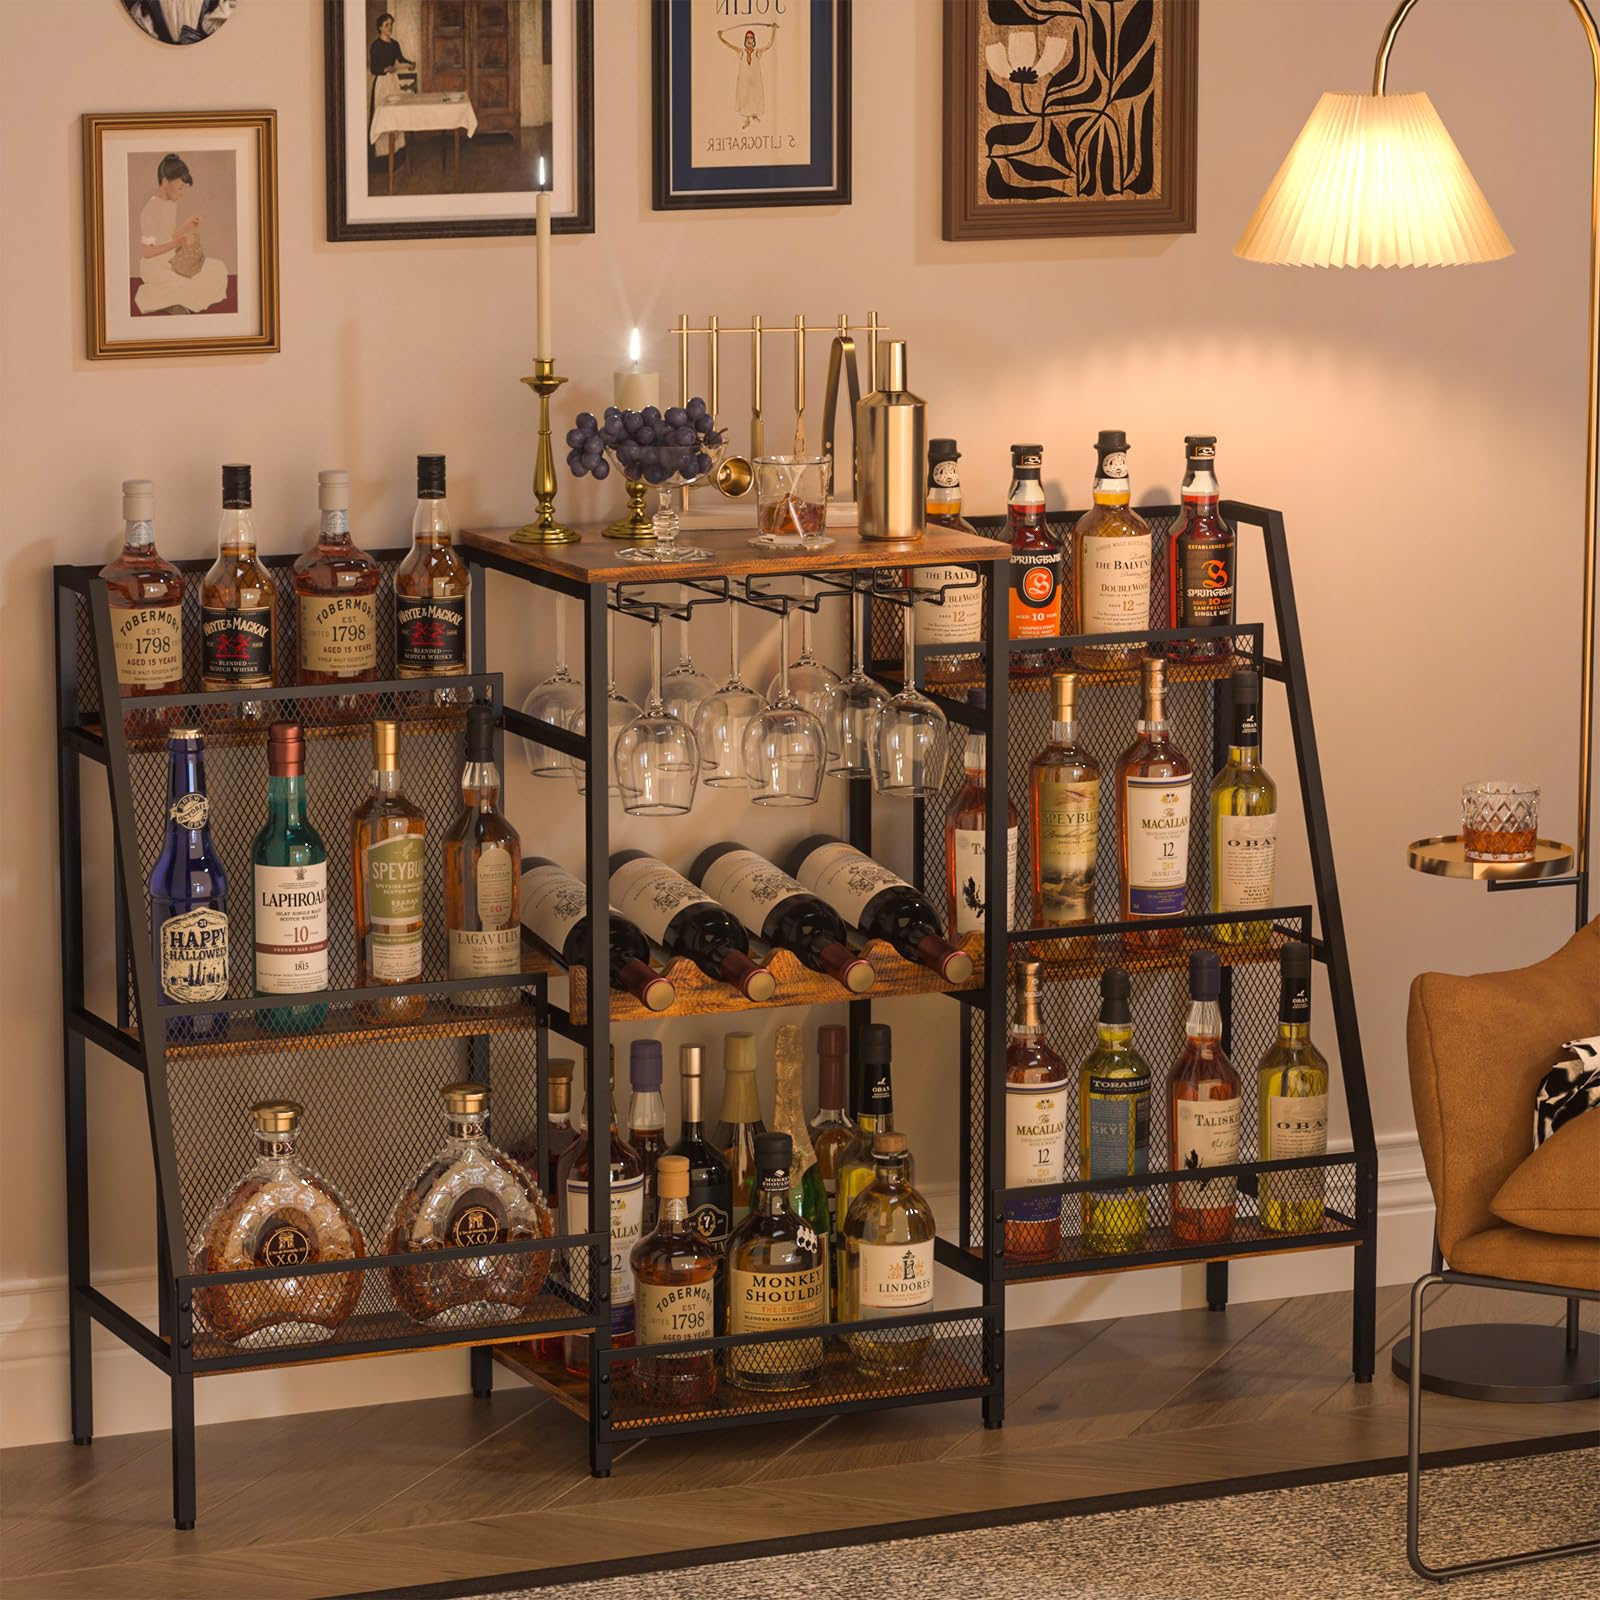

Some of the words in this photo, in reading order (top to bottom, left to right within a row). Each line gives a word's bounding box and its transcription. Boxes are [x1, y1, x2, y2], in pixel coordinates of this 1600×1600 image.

[1096, 561, 1112, 569] THE
[925, 571, 940, 580] THE
[1123, 600, 1134, 612] 12
[1208, 597, 1220, 605] 10
[316, 598, 375, 625] TOBERMORY
[428, 605, 463, 625] MACKAY
[953, 611, 965, 622] 12
[1032, 613, 1045, 622] 10
[120, 610, 180, 637] TOBERMORY
[232, 616, 269, 638] MACKAY
[332, 624, 366, 642] 1798
[136, 636, 170, 654] 1798
[354, 643, 371, 653] YEARS
[158, 655, 176, 665] YEARS
[209, 665, 231, 673] SCOTCH
[1142, 816, 1188, 829] MACALLAN
[1163, 841, 1175, 856] 12
[170, 927, 226, 949] HAPPY
[294, 925, 309, 943] 10
[295, 962, 309, 971] 1815
[1016, 1121, 1064, 1136] MACALLAN
[1092, 1126, 1127, 1135] SKYE
[1038, 1148, 1050, 1164] 12
[703, 1216, 711, 1229] 7
[879, 1279, 930, 1293] LINDORES
[672, 1311, 704, 1330] 1798
